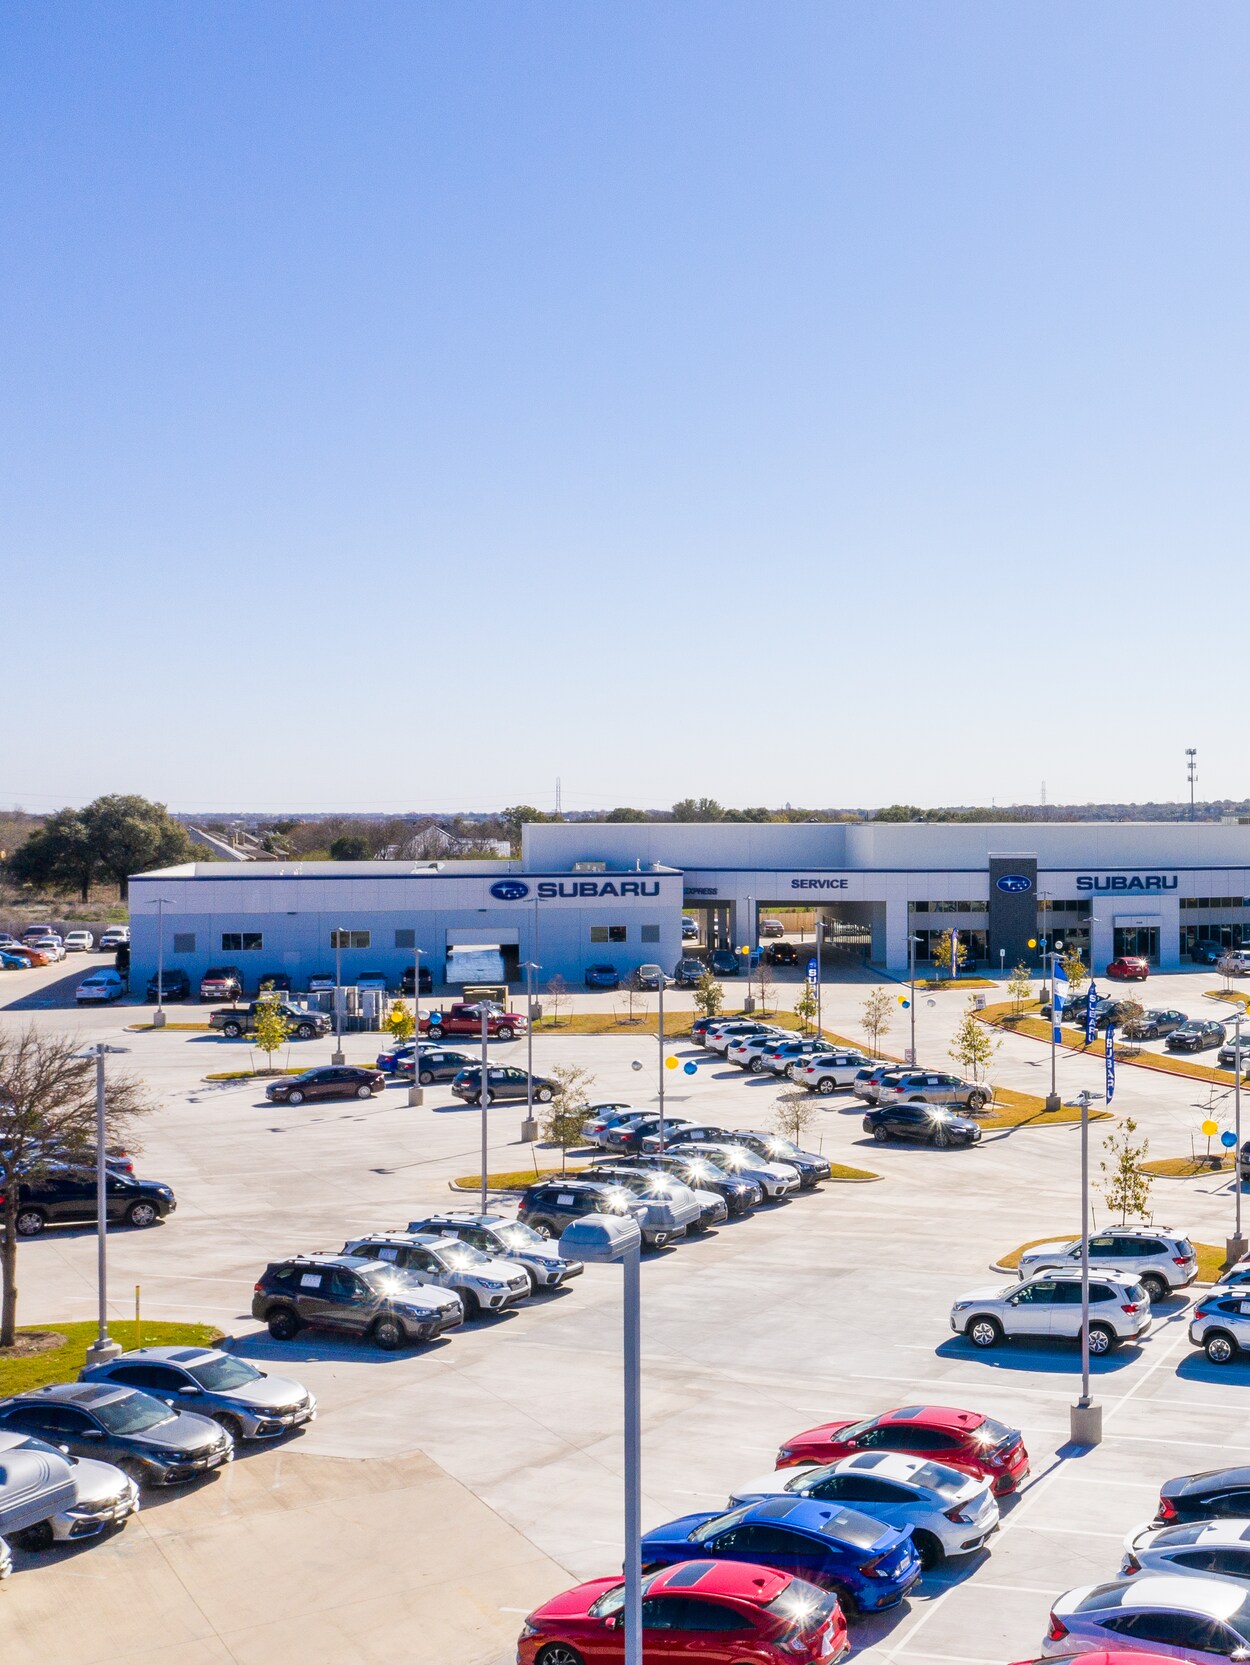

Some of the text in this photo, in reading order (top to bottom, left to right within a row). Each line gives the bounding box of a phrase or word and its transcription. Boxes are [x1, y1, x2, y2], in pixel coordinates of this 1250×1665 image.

[537, 881, 661, 898] SUBARU
[791, 879, 849, 889] SERVICE
[1076, 875, 1178, 890] SUBARU
